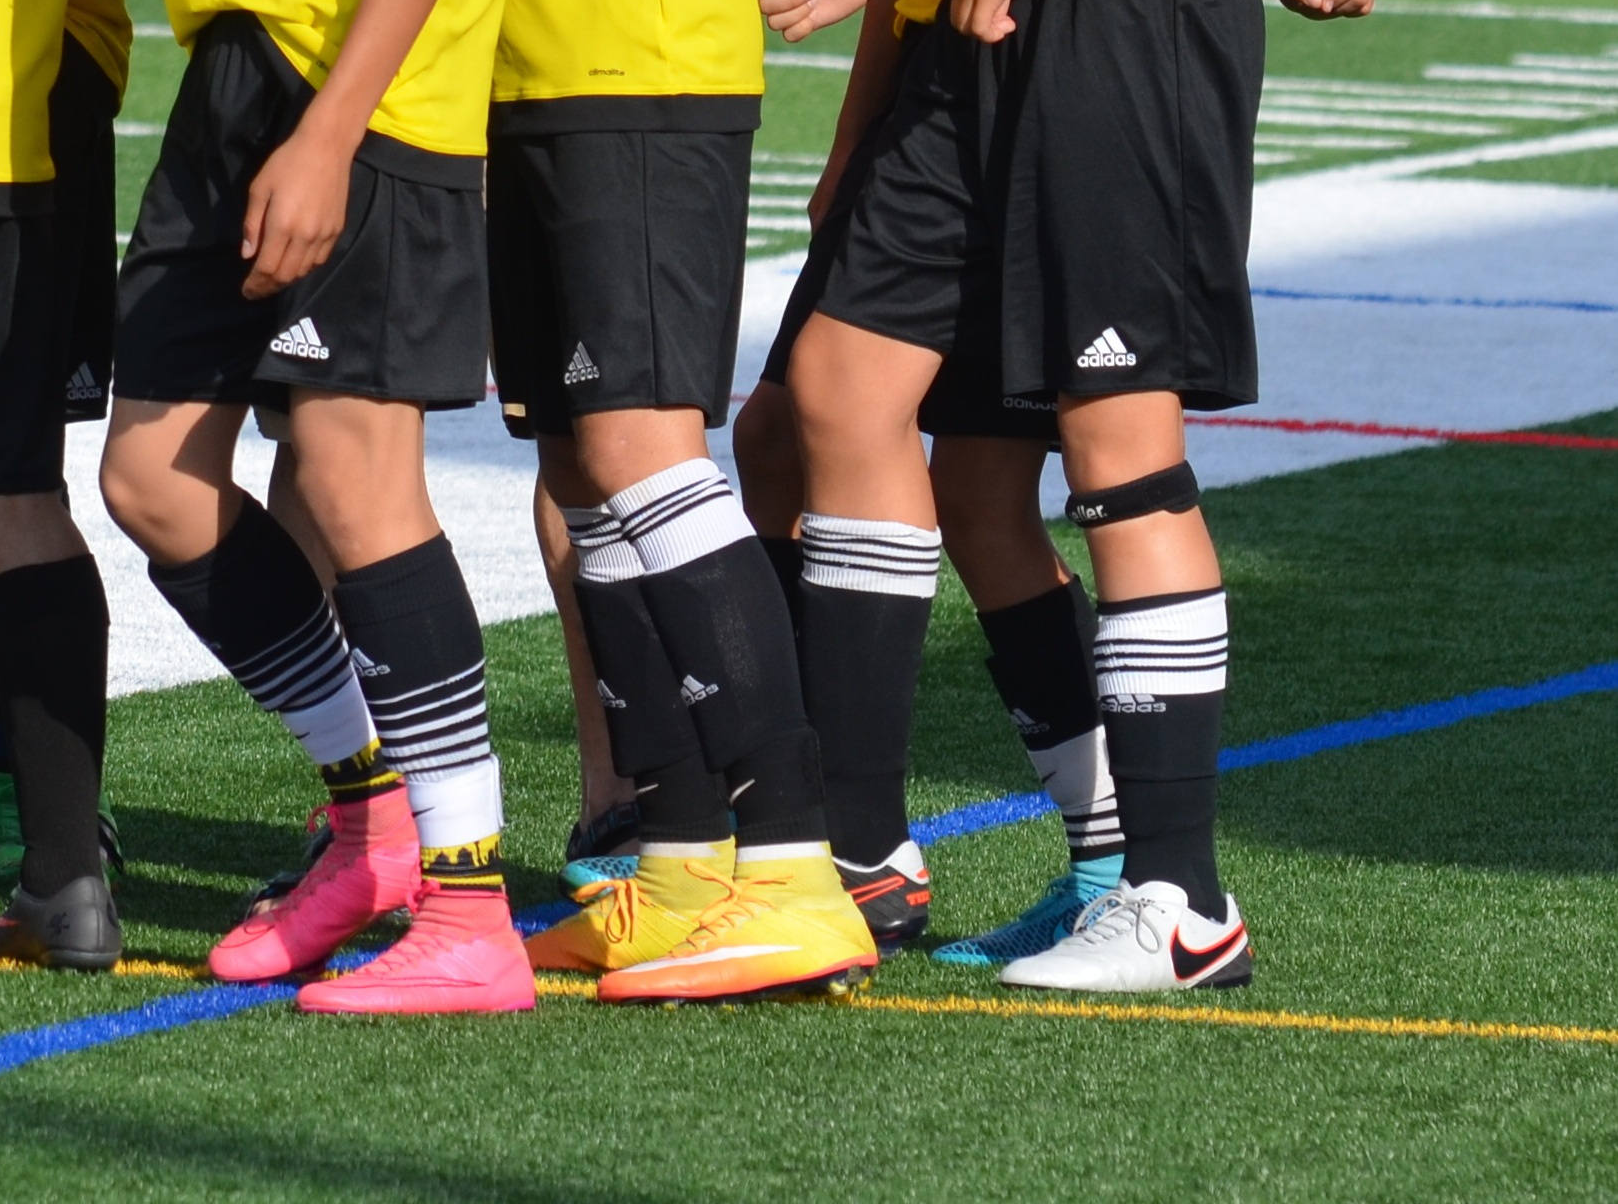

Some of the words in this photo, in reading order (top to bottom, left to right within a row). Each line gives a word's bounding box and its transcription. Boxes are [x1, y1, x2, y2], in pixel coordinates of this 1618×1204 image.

[270, 338, 330, 360] adidas
[1076, 352, 1137, 368] adidas
[564, 365, 600, 385] adidas
